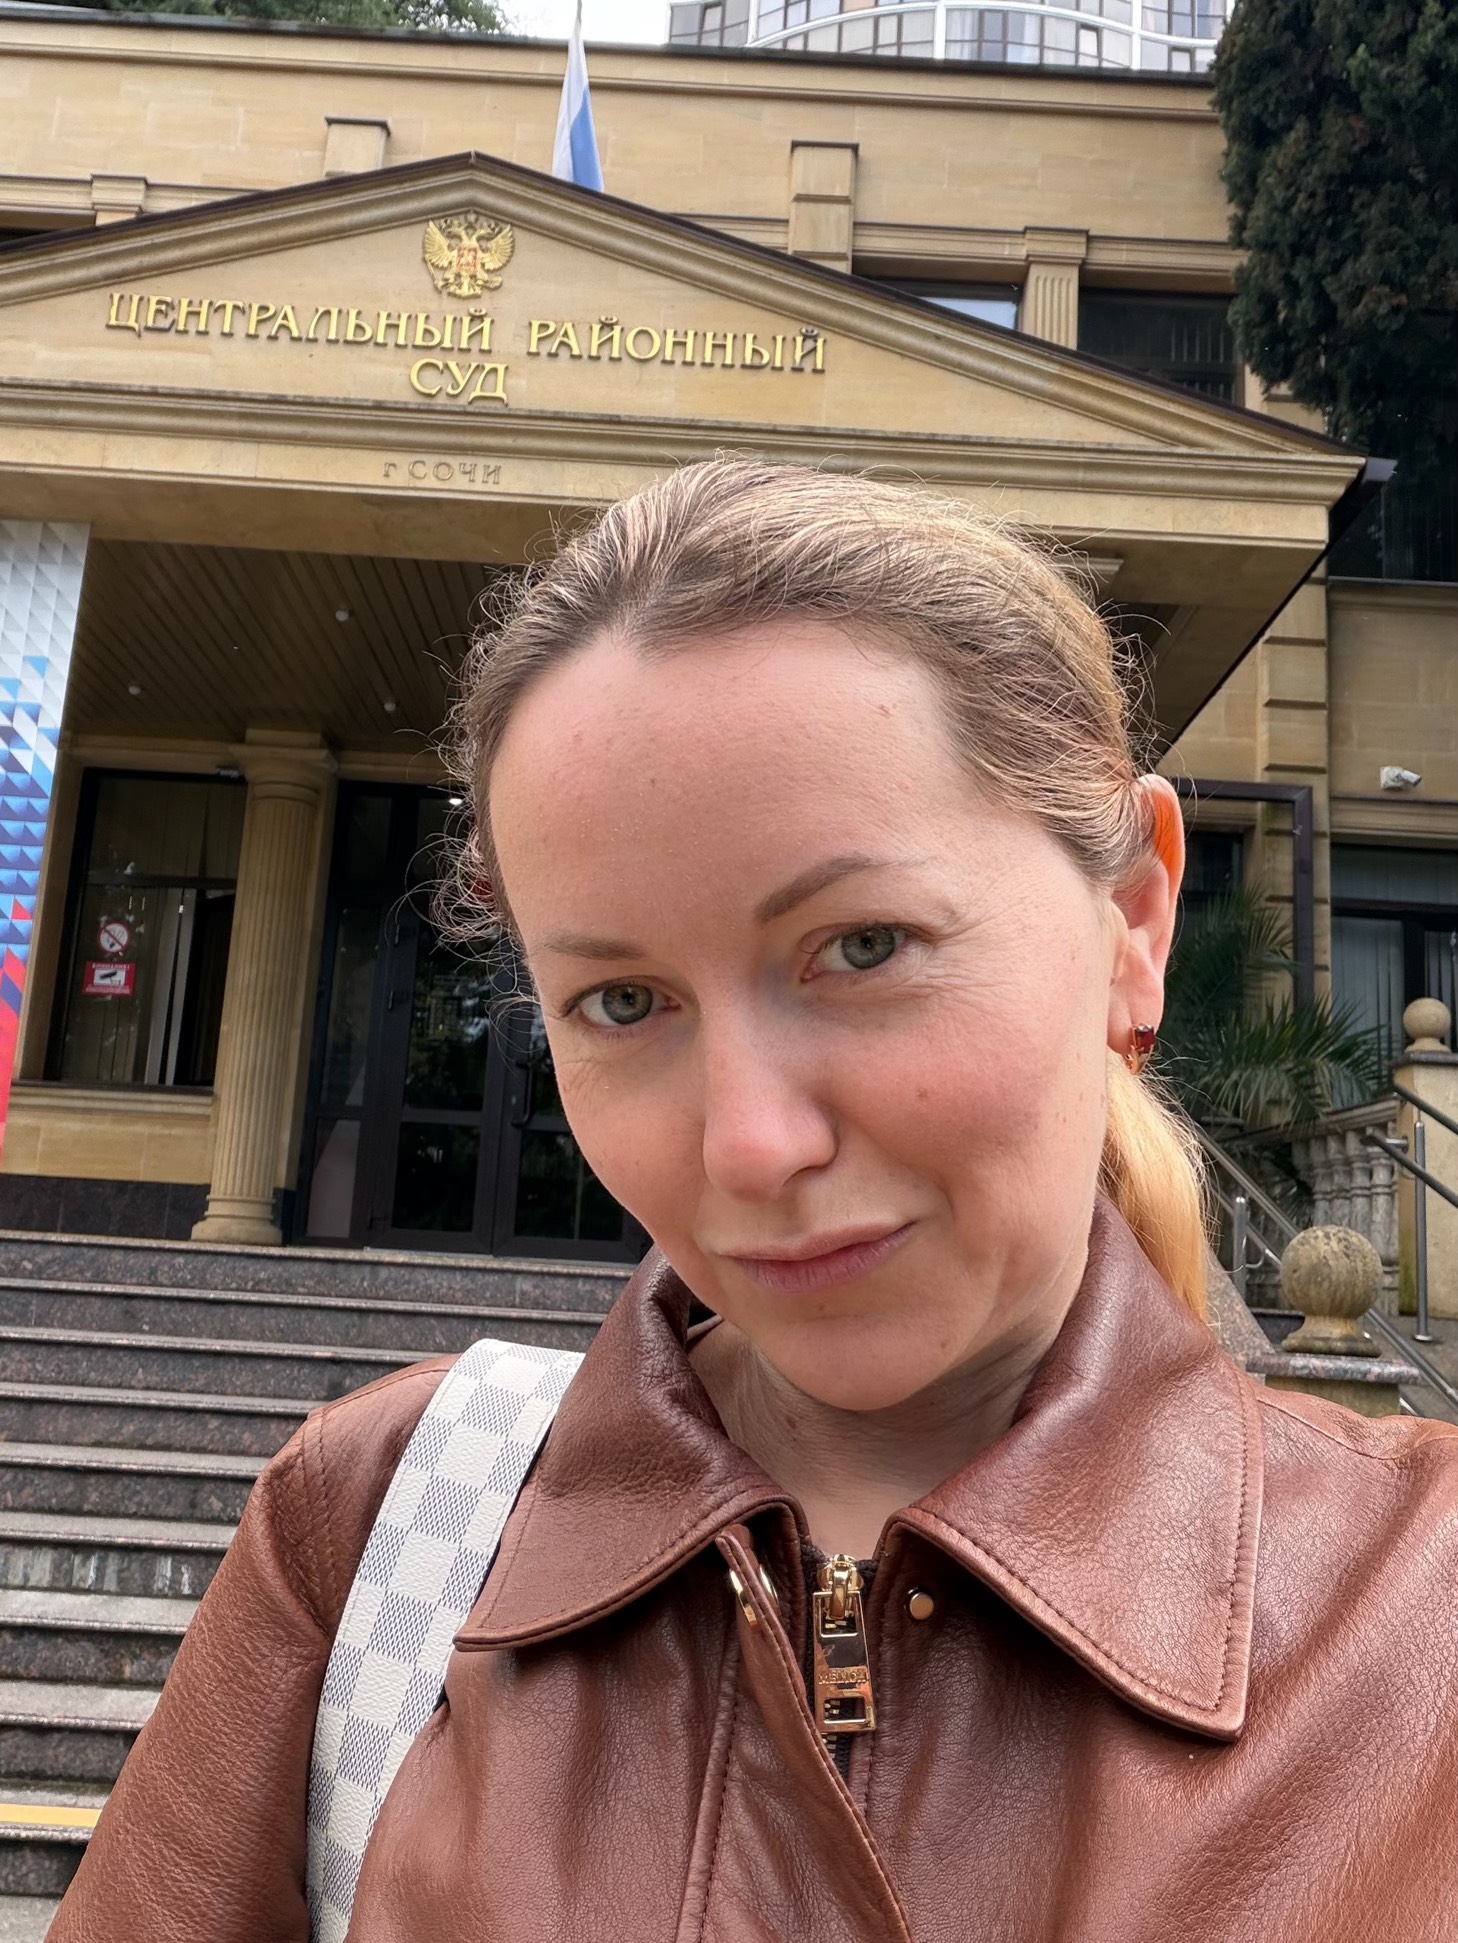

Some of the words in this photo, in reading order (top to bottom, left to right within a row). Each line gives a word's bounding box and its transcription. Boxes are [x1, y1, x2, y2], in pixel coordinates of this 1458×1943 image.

[106, 292, 493, 353] ЦЕНТРАЛЬНЫЙ
[527, 315, 827, 373] РАЙОННЫЙ
[409, 358, 511, 405] СУД
[408, 460, 502, 485] СОЧИ
